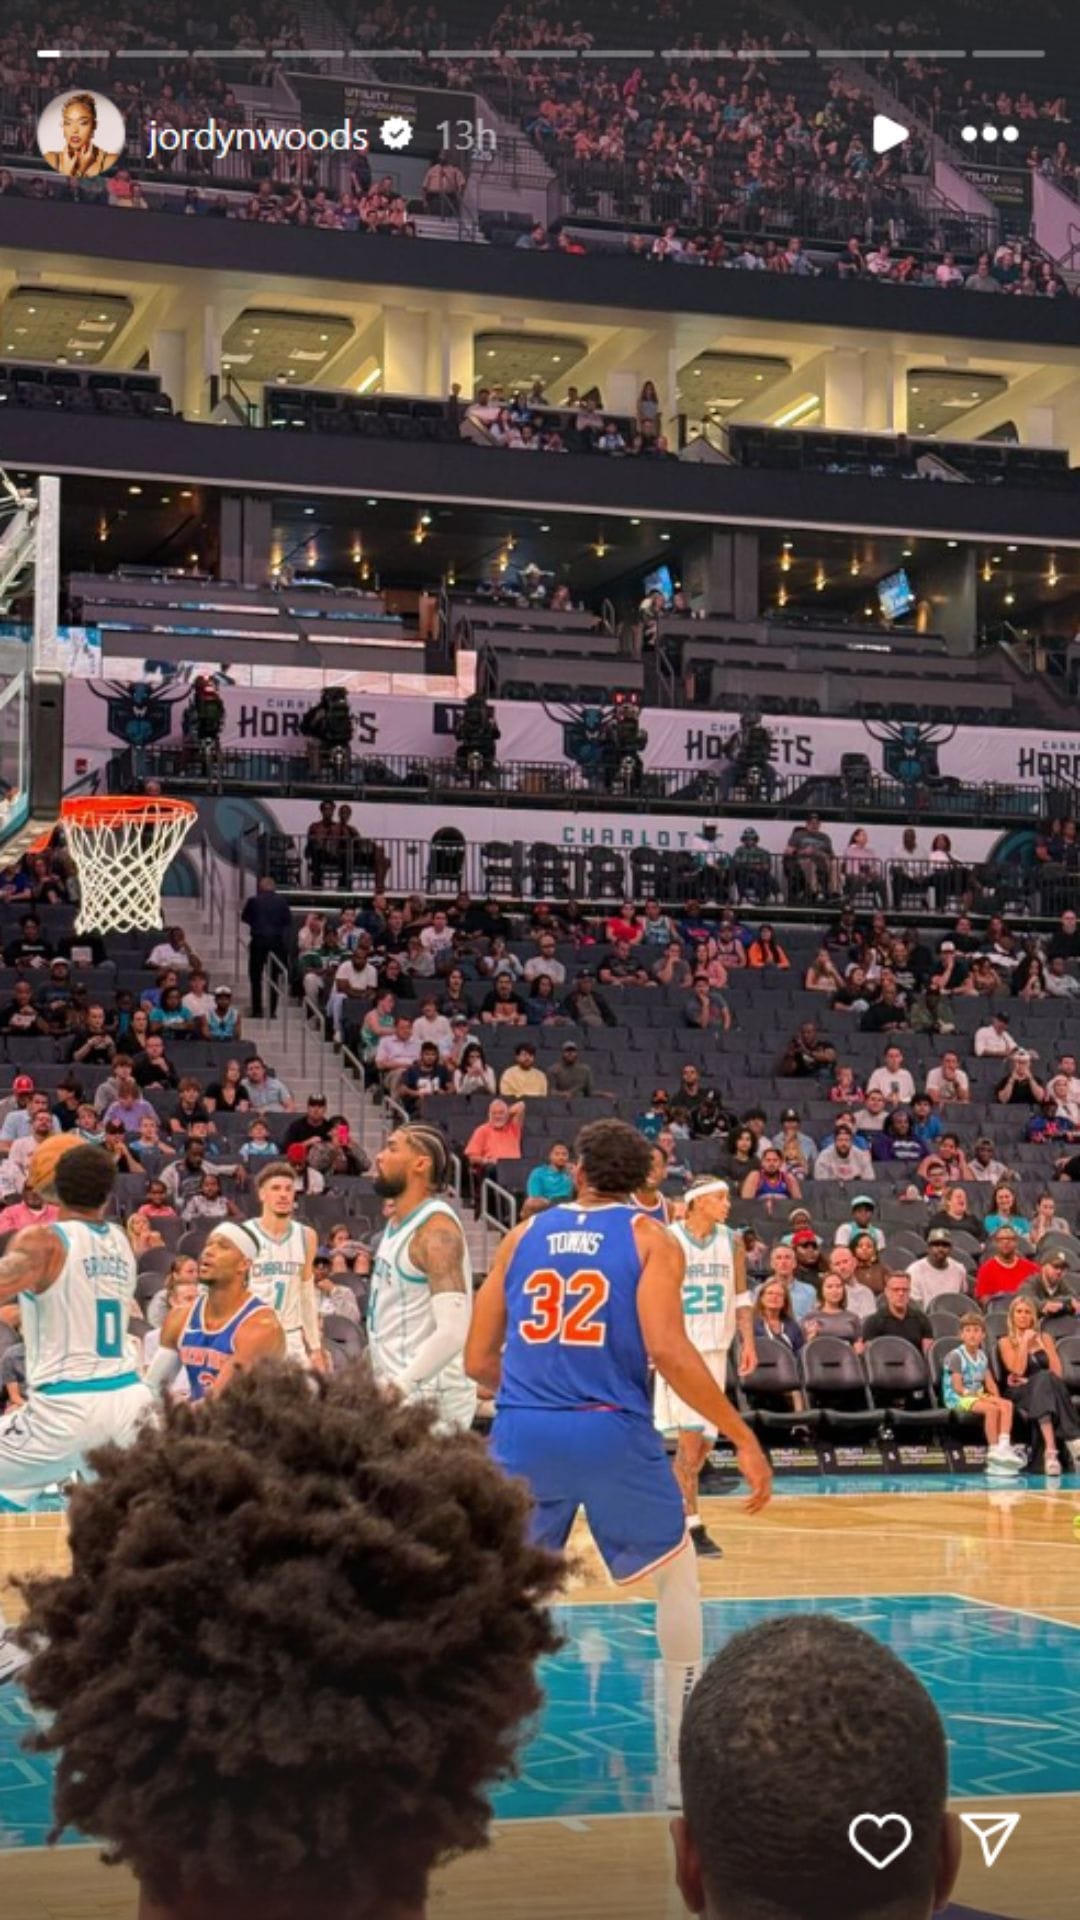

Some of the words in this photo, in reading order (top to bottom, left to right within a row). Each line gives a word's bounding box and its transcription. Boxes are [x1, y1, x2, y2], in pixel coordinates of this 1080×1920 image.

[238, 705, 378, 744] HORS
[684, 729, 814, 767] HOETS
[563, 827, 688, 847] CHARLOT
[546, 1231, 604, 1255] TOWNS
[274, 1280, 286, 1311] 1
[519, 1268, 610, 1346] 32
[683, 1284, 725, 1316] 23
[96, 1299, 122, 1358] 0
